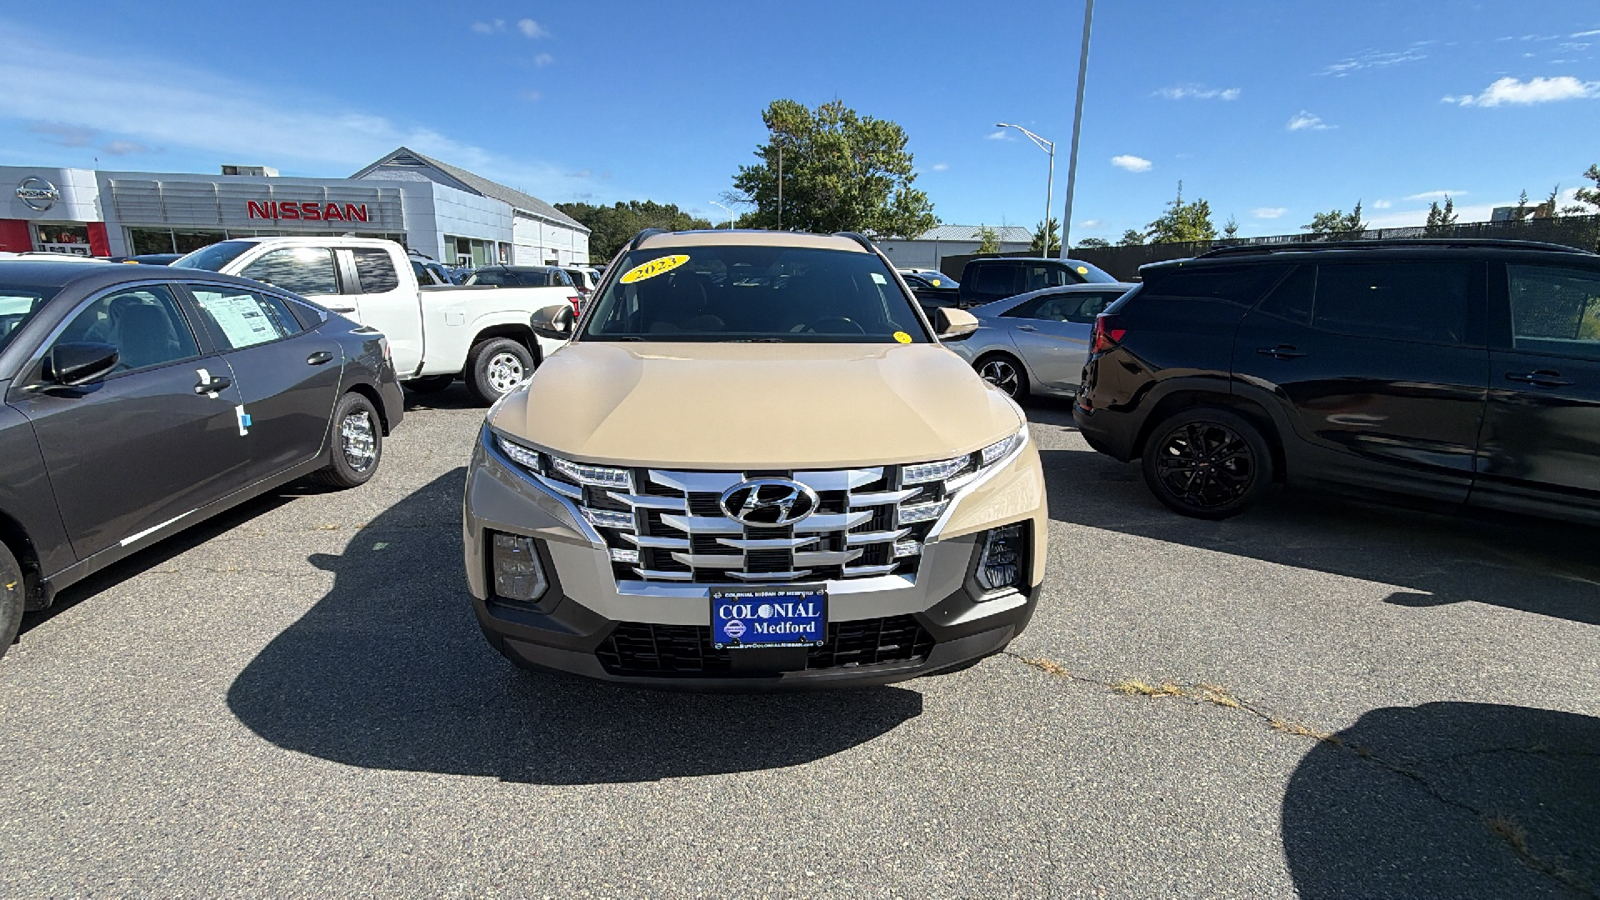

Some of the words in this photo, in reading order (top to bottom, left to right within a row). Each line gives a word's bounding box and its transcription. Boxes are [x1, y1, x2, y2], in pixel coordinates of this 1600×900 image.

[247, 201, 368, 222] NISSAN
[635, 257, 677, 280] 2023
[719, 603, 820, 619] COLONIAL
[753, 622, 815, 634] Medford
